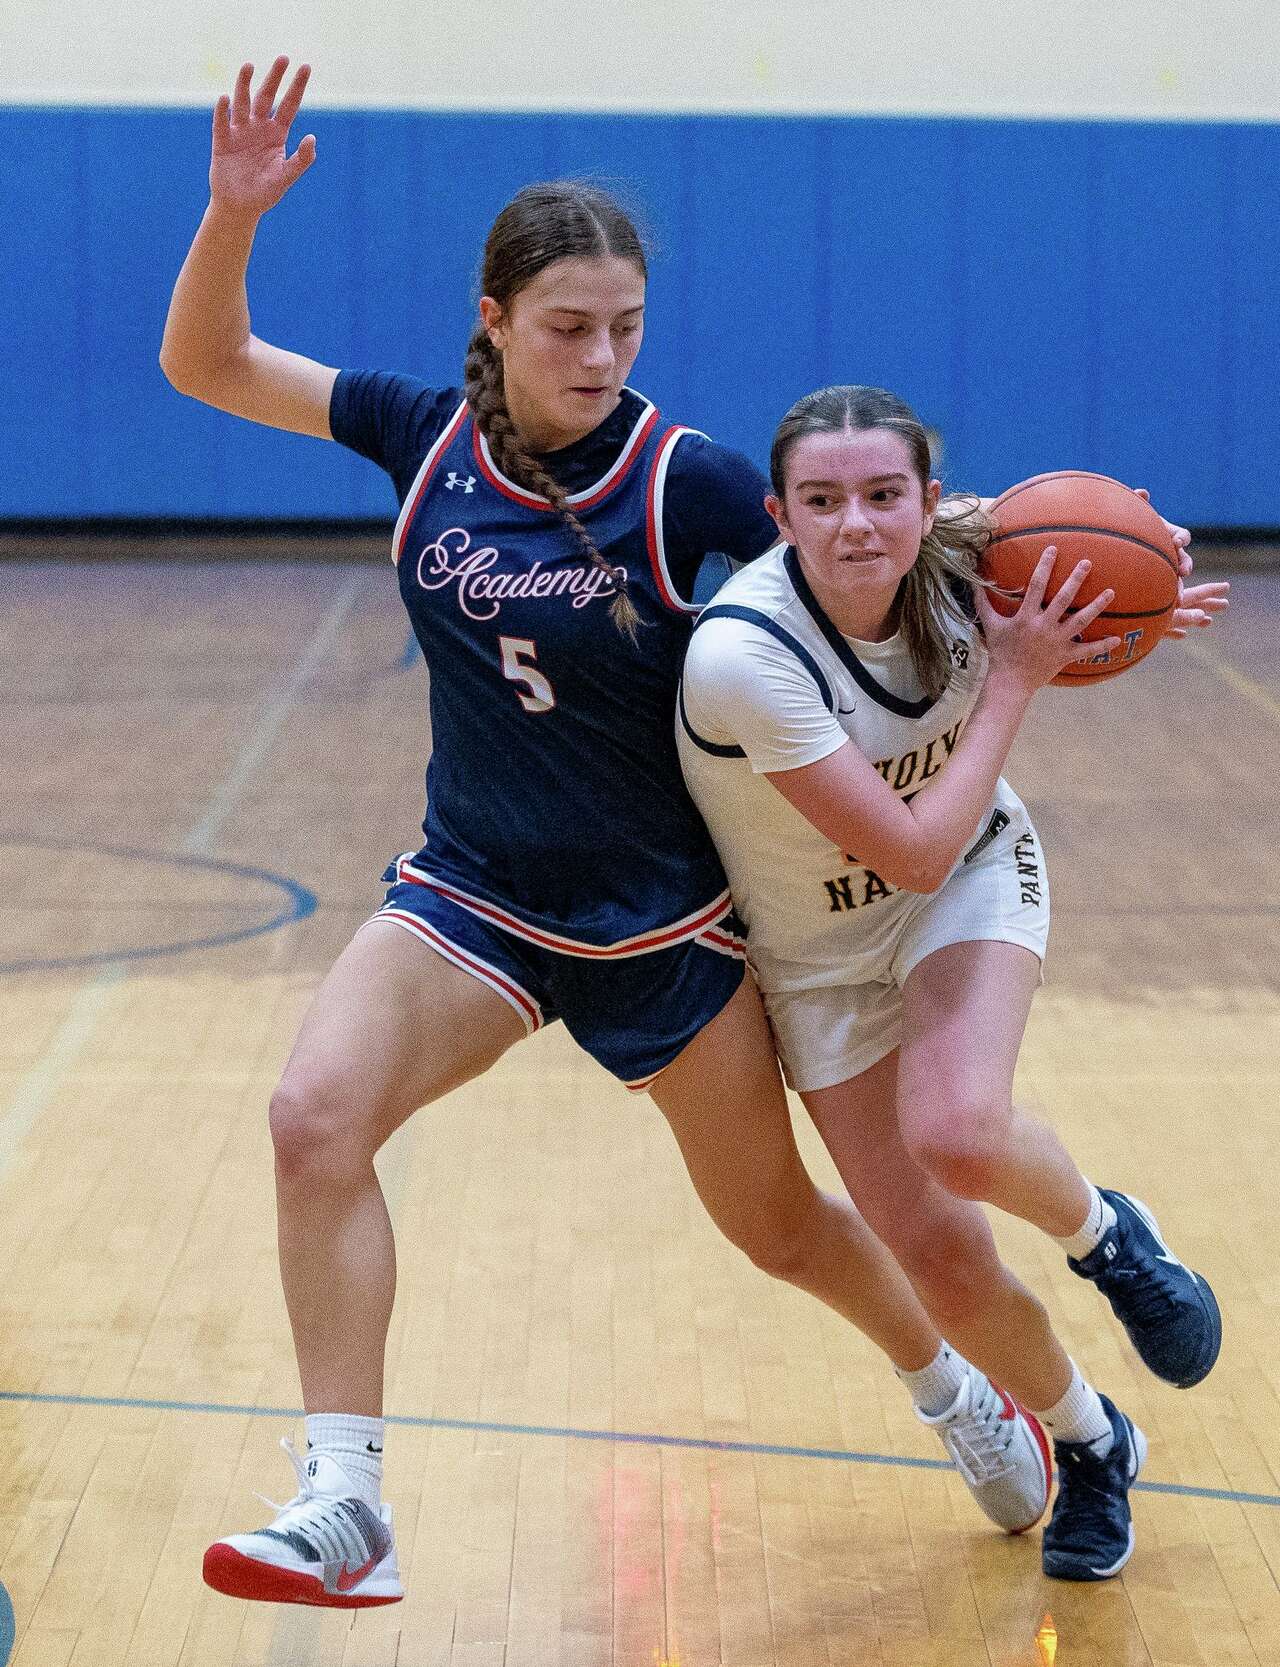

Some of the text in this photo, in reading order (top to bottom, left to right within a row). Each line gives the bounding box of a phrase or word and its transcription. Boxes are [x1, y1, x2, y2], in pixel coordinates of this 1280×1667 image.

[417, 527, 628, 621] Academy
[498, 635, 556, 714] 5
[824, 869, 901, 912] NA
